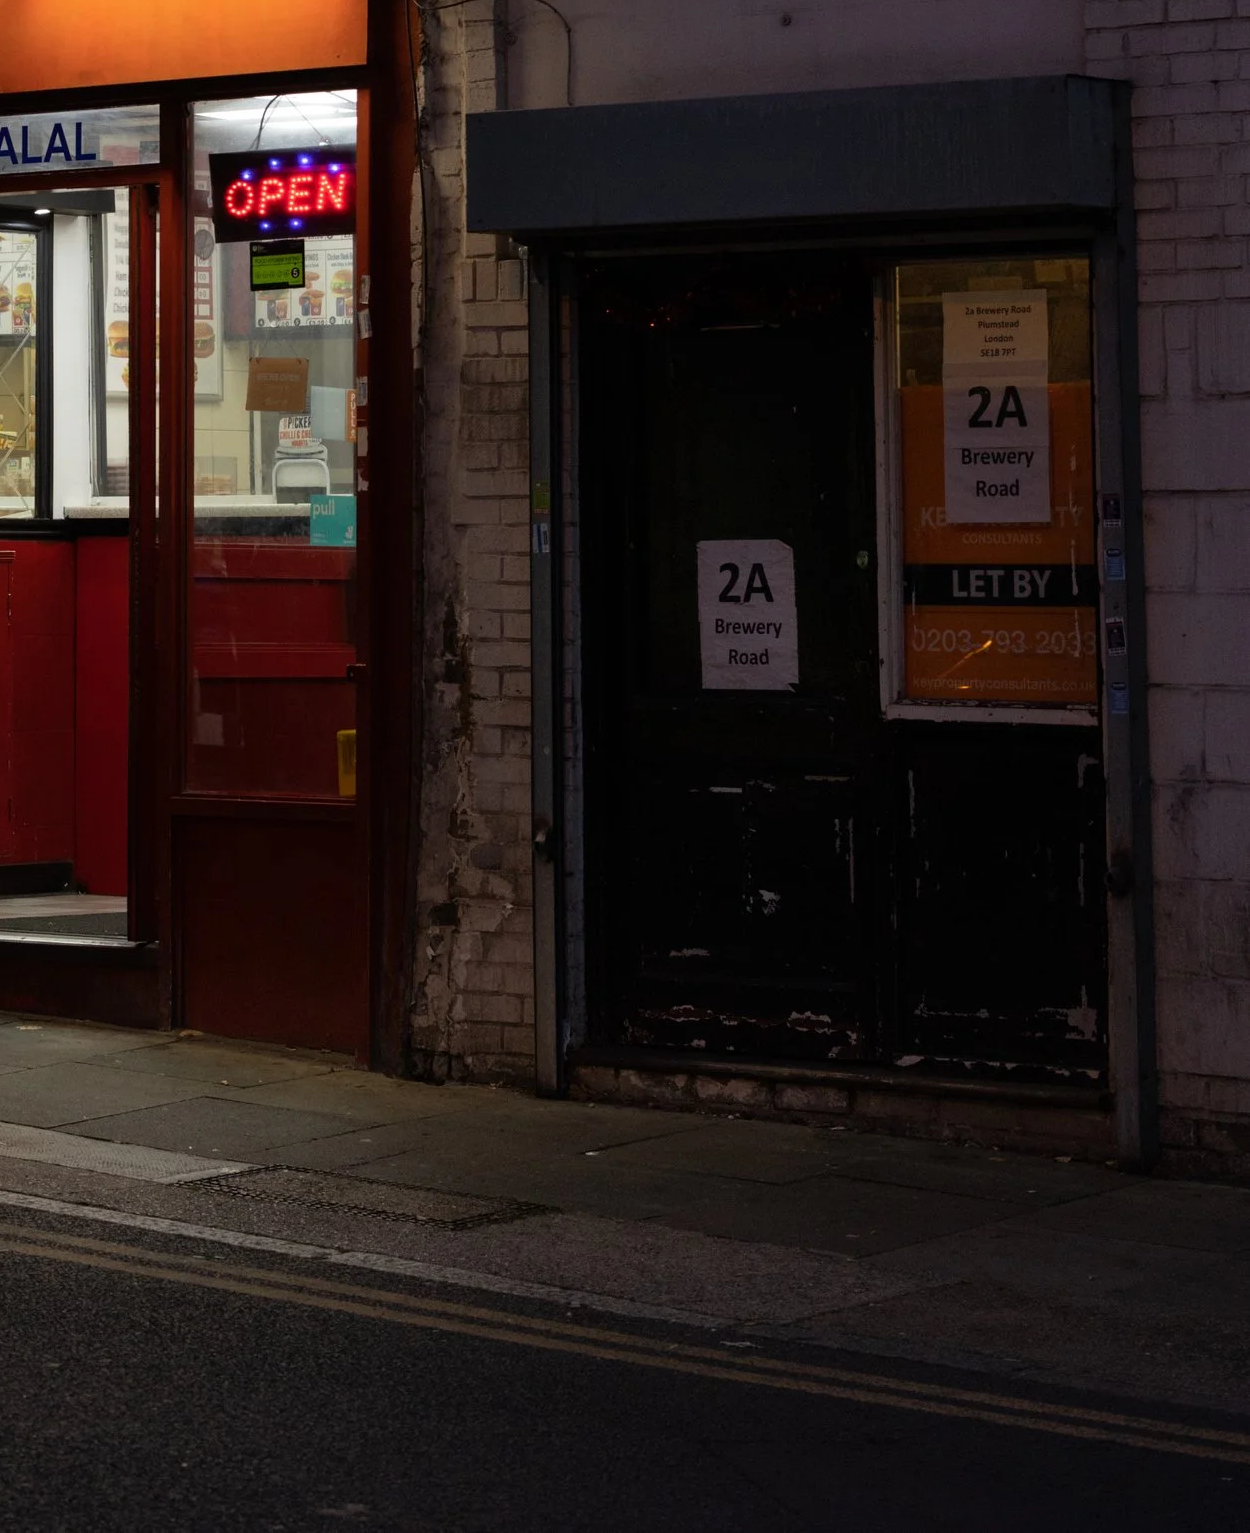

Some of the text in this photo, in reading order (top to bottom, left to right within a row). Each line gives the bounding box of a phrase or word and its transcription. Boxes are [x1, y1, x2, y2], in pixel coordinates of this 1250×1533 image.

[226, 173, 347, 216] OPEN
[965, 305, 1031, 316] 2a Brewery Road
[978, 320, 1019, 329] Plumstead
[984, 335, 1013, 343] London
[980, 348, 1016, 357] SE18 7PT
[968, 386, 1028, 428] 2A
[961, 448, 1034, 468] Brewery
[976, 479, 1020, 497] Road
[313, 499, 335, 519] pull
[962, 532, 1043, 545] CONSULTANTS
[719, 562, 774, 603] 2A
[952, 569, 1051, 598] LET BY
[715, 618, 782, 639] Brewery
[728, 649, 769, 665] Road
